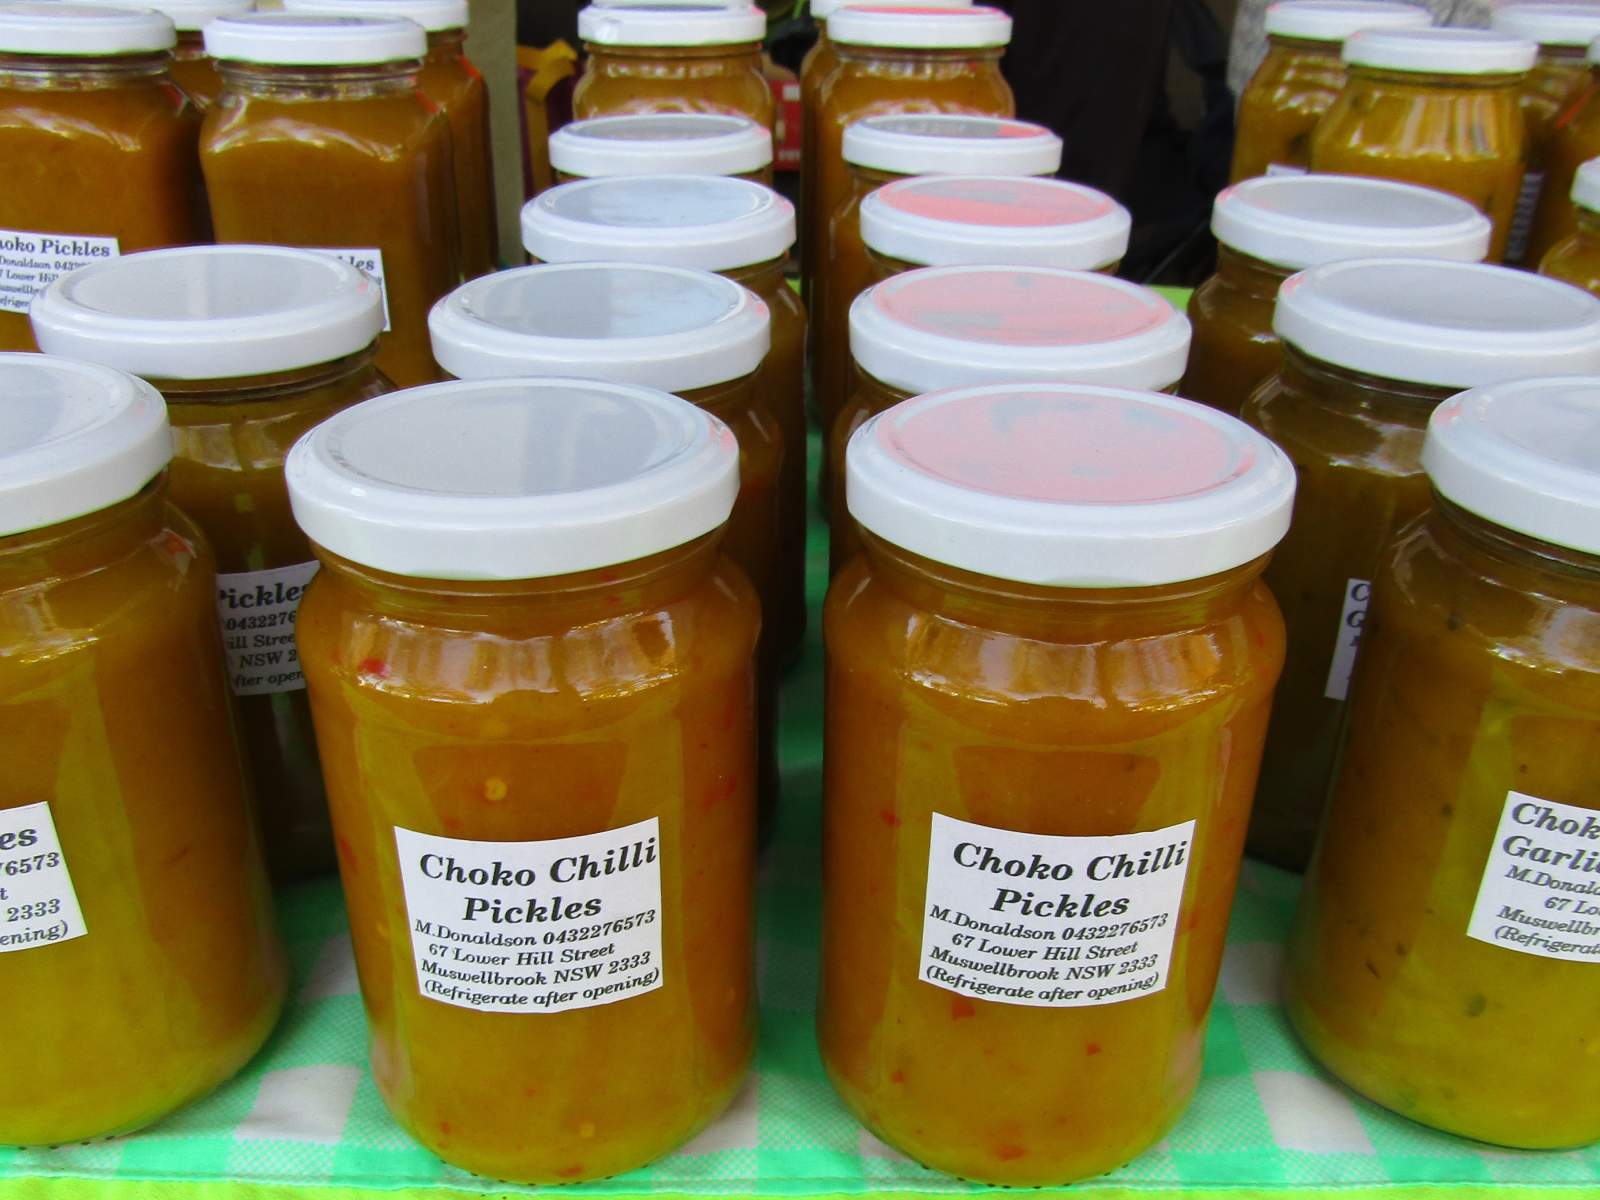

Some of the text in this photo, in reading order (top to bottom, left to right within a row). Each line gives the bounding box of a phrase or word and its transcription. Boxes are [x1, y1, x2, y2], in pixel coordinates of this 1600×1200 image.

[40, 238, 111, 257] Pickles
[239, 652, 283, 669] NSW
[419, 837, 657, 887] Choko Chilli
[953, 841, 1188, 882] Choko Chilli
[7, 898, 61, 923] 2333
[462, 896, 602, 924] Pickles
[989, 888, 1130, 918] Pickles
[1544, 896, 1600, 916] 67 Lo
[414, 909, 656, 947] M.Donaldson 0432276573
[929, 904, 1169, 941] M.Donaldson 0432276573
[428, 943, 615, 967] 67 Lower Hill Street
[928, 945, 1158, 981] Muswellbrook NSW 2333
[951, 933, 1138, 961] 67 Lower Hill Street
[421, 951, 652, 986] Muswellbrook NSW 2333
[926, 965, 1160, 1003] (Refrigerate after opening)
[424, 967, 660, 1008] (Refrigerate after opening)
